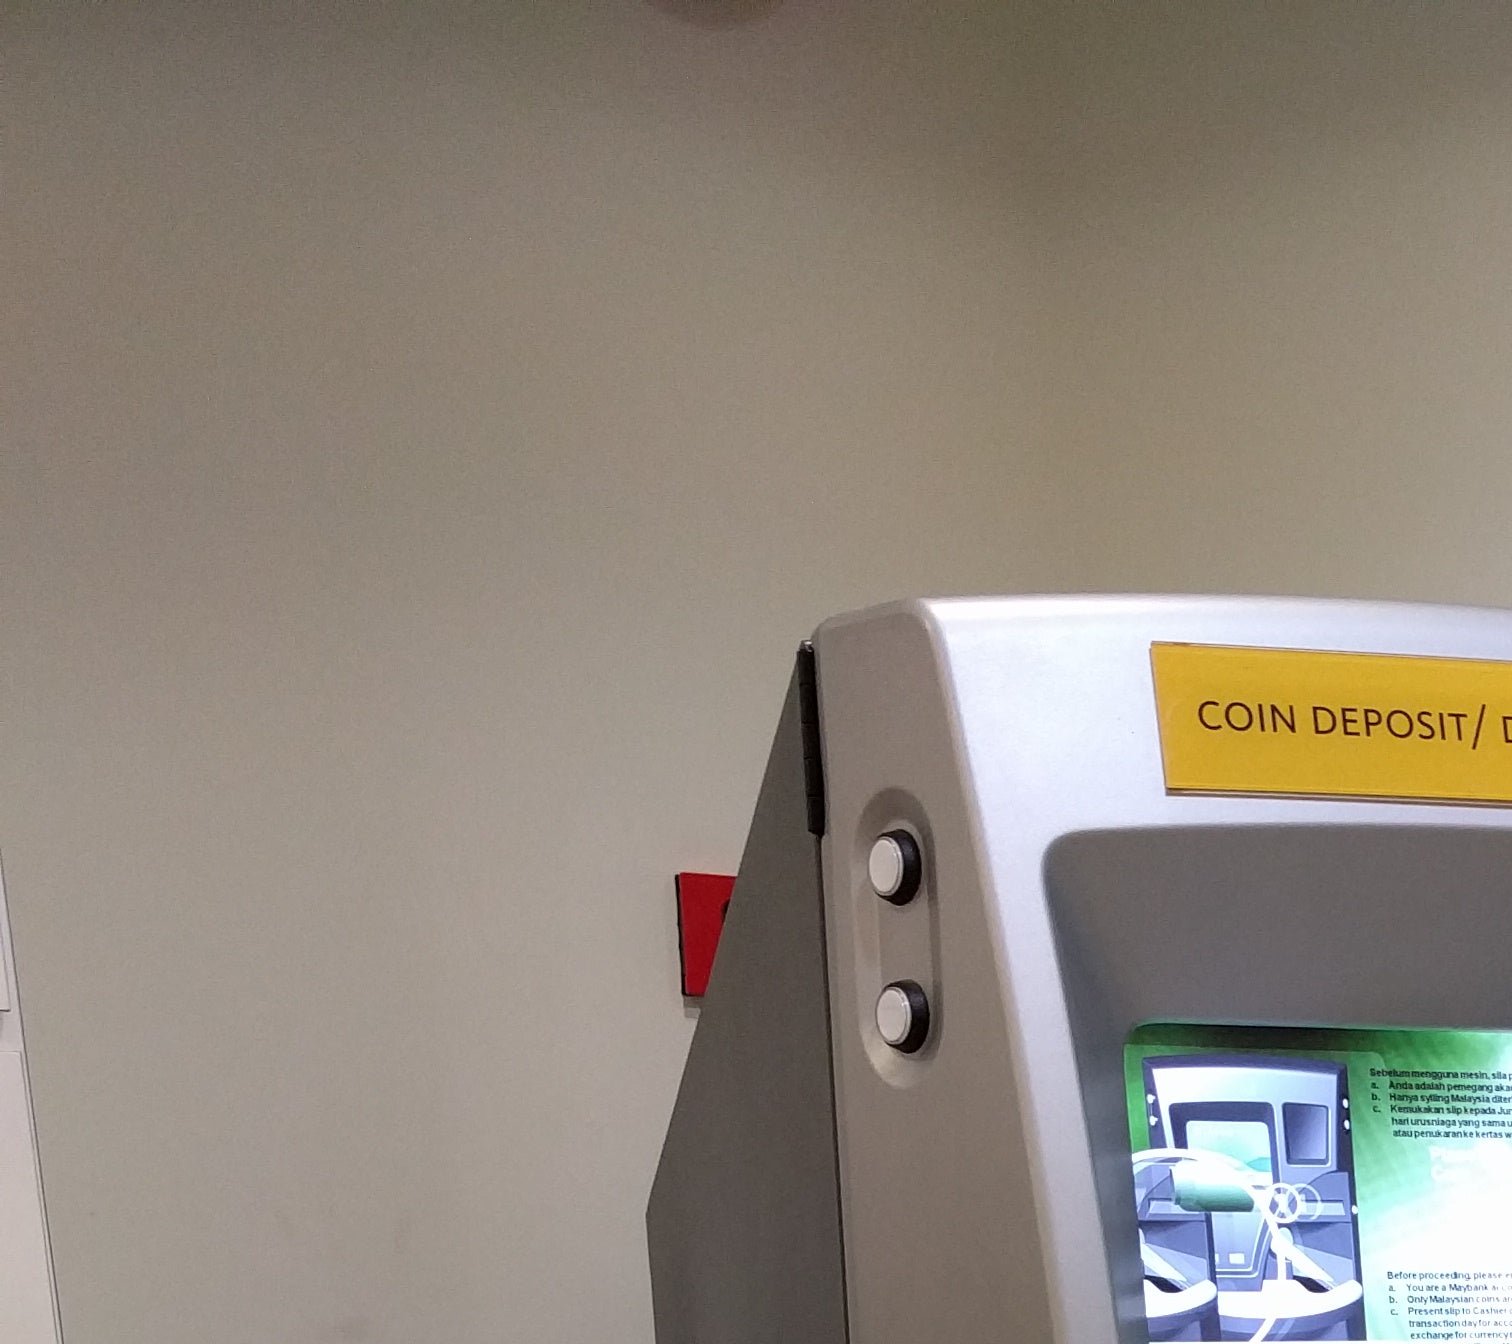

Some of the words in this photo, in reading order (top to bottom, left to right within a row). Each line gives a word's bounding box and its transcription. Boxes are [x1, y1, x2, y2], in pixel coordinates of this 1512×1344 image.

[1198, 700, 1297, 733] COIN
[1311, 704, 1486, 749] DEPOSIT/
[1370, 1068, 1411, 1077] Sebelum
[1411, 1070, 1459, 1080] mengguna
[1461, 1071, 1490, 1080] mesin,
[1492, 1071, 1507, 1079] sila
[1415, 1083, 1445, 1091] adalah
[1447, 1085, 1493, 1093] pemegang
[1390, 1094, 1418, 1102] Hanya
[1451, 1095, 1490, 1104] Malaysia
[1391, 1106, 1444, 1114] Kemukakan
[1446, 1107, 1462, 1116] slip
[1464, 1107, 1496, 1116] kepada
[1392, 1117, 1409, 1125] hari
[1410, 1118, 1456, 1128] urusniaga
[1458, 1120, 1480, 1128] yang
[1415, 1130, 1462, 1138] penukaran
[1463, 1130, 1473, 1138] ke
[1474, 1272, 1502, 1280] please
[1449, 1283, 1488, 1292] Maybank
[1407, 1296, 1428, 1305] Only
[1430, 1296, 1474, 1304] Malaysian
[1408, 1307, 1443, 1315] Present
[1445, 1307, 1461, 1316] slip
[1409, 1320, 1460, 1328] transaction
[1462, 1320, 1477, 1328] day
[1411, 1332, 1454, 1340] exchange
[1469, 1332, 1509, 1340] currency
